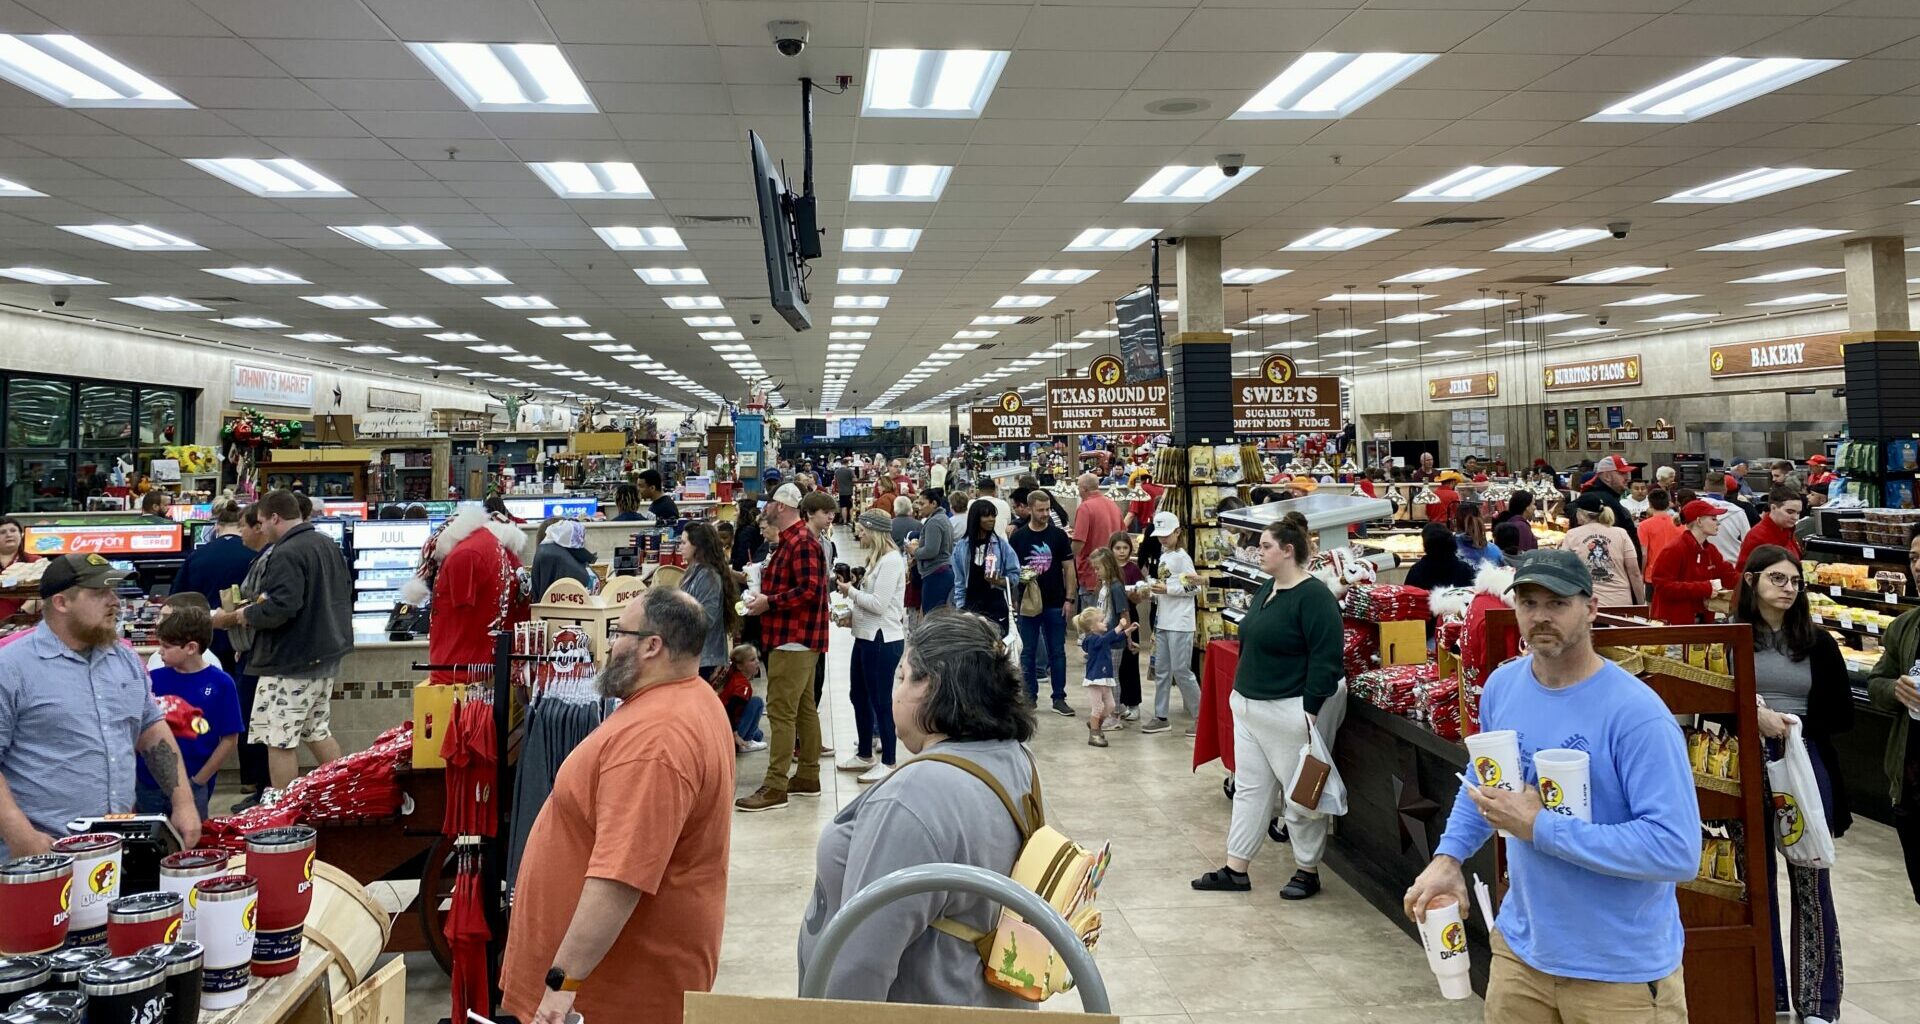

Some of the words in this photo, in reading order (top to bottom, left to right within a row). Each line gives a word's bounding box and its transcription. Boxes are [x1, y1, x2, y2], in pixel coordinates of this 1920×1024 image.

[1751, 343, 1805, 367] BAKERY
[1554, 366, 1590, 385] BURRITOS
[1591, 365, 1598, 381] &
[1599, 362, 1625, 381] TACOS
[236, 368, 277, 390] JOHNNY'S
[279, 374, 309, 394] MARKET
[1449, 379, 1472, 394] JERKY
[1051, 388, 1095, 404] TEXAS
[1097, 386, 1145, 403] ROUND
[1147, 386, 1166, 401] UP
[1242, 386, 1318, 403] SWEETS
[1062, 409, 1104, 418] BRISKET
[1111, 407, 1156, 417] SAUSAGE
[1245, 409, 1289, 418] SUGARED
[1290, 409, 1316, 418] NUTS
[992, 415, 1033, 426] ORDER
[1052, 420, 1093, 429] TURKEY
[1100, 418, 1137, 428] PULLED
[1139, 418, 1167, 427] PORK
[1266, 419, 1292, 428] DOTS
[1299, 419, 1330, 427] FUDGE
[998, 427, 1031, 438] HERE
[379, 531, 405, 543] JUUL
